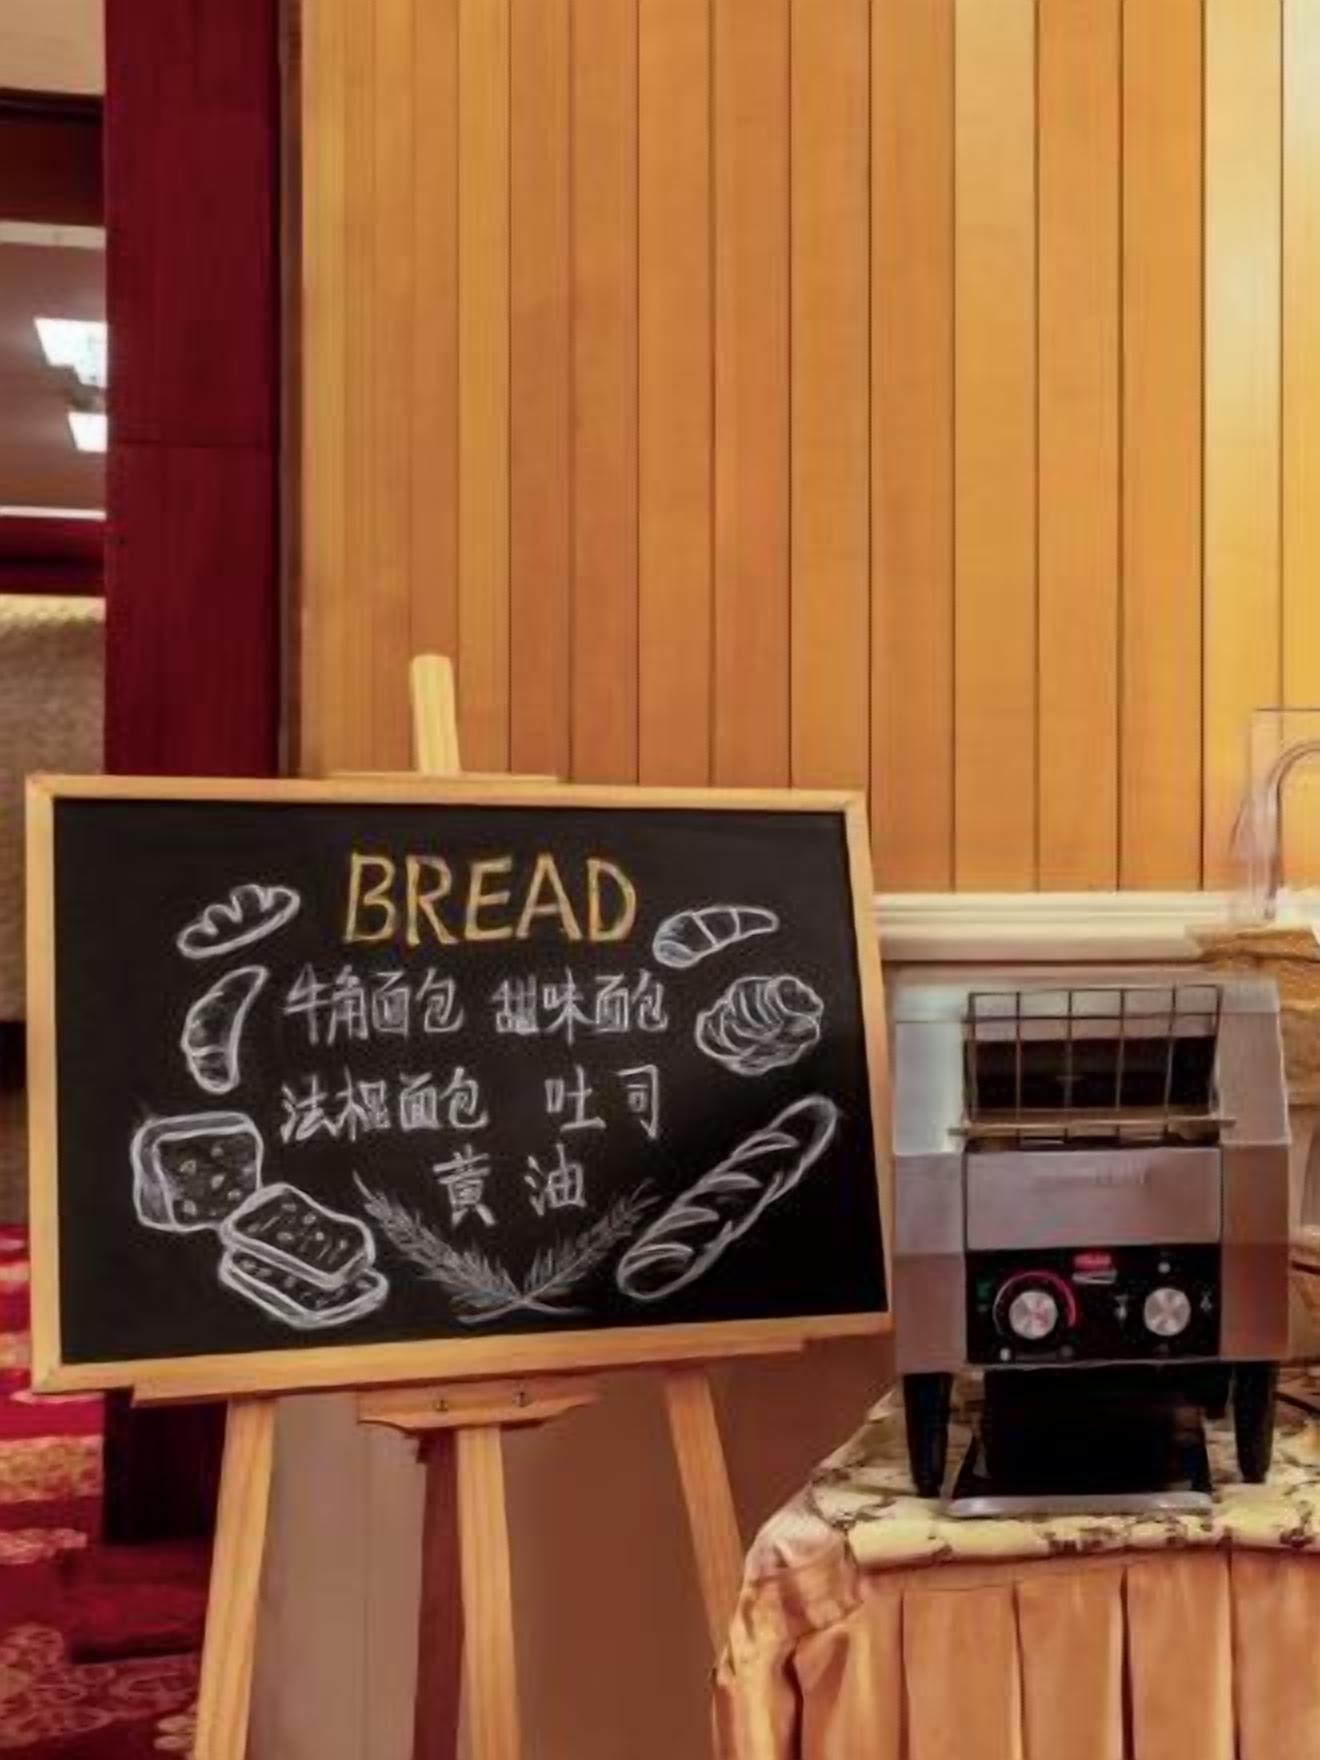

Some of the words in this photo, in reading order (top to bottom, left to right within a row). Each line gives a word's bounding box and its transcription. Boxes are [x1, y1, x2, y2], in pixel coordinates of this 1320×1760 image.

[343, 852, 638, 946] BREAD
[284, 963, 465, 1045] 牛角面包
[491, 965, 669, 1046] 甜味面包
[544, 1064, 660, 1140] 吐司
[432, 1143, 587, 1226] 黄油
